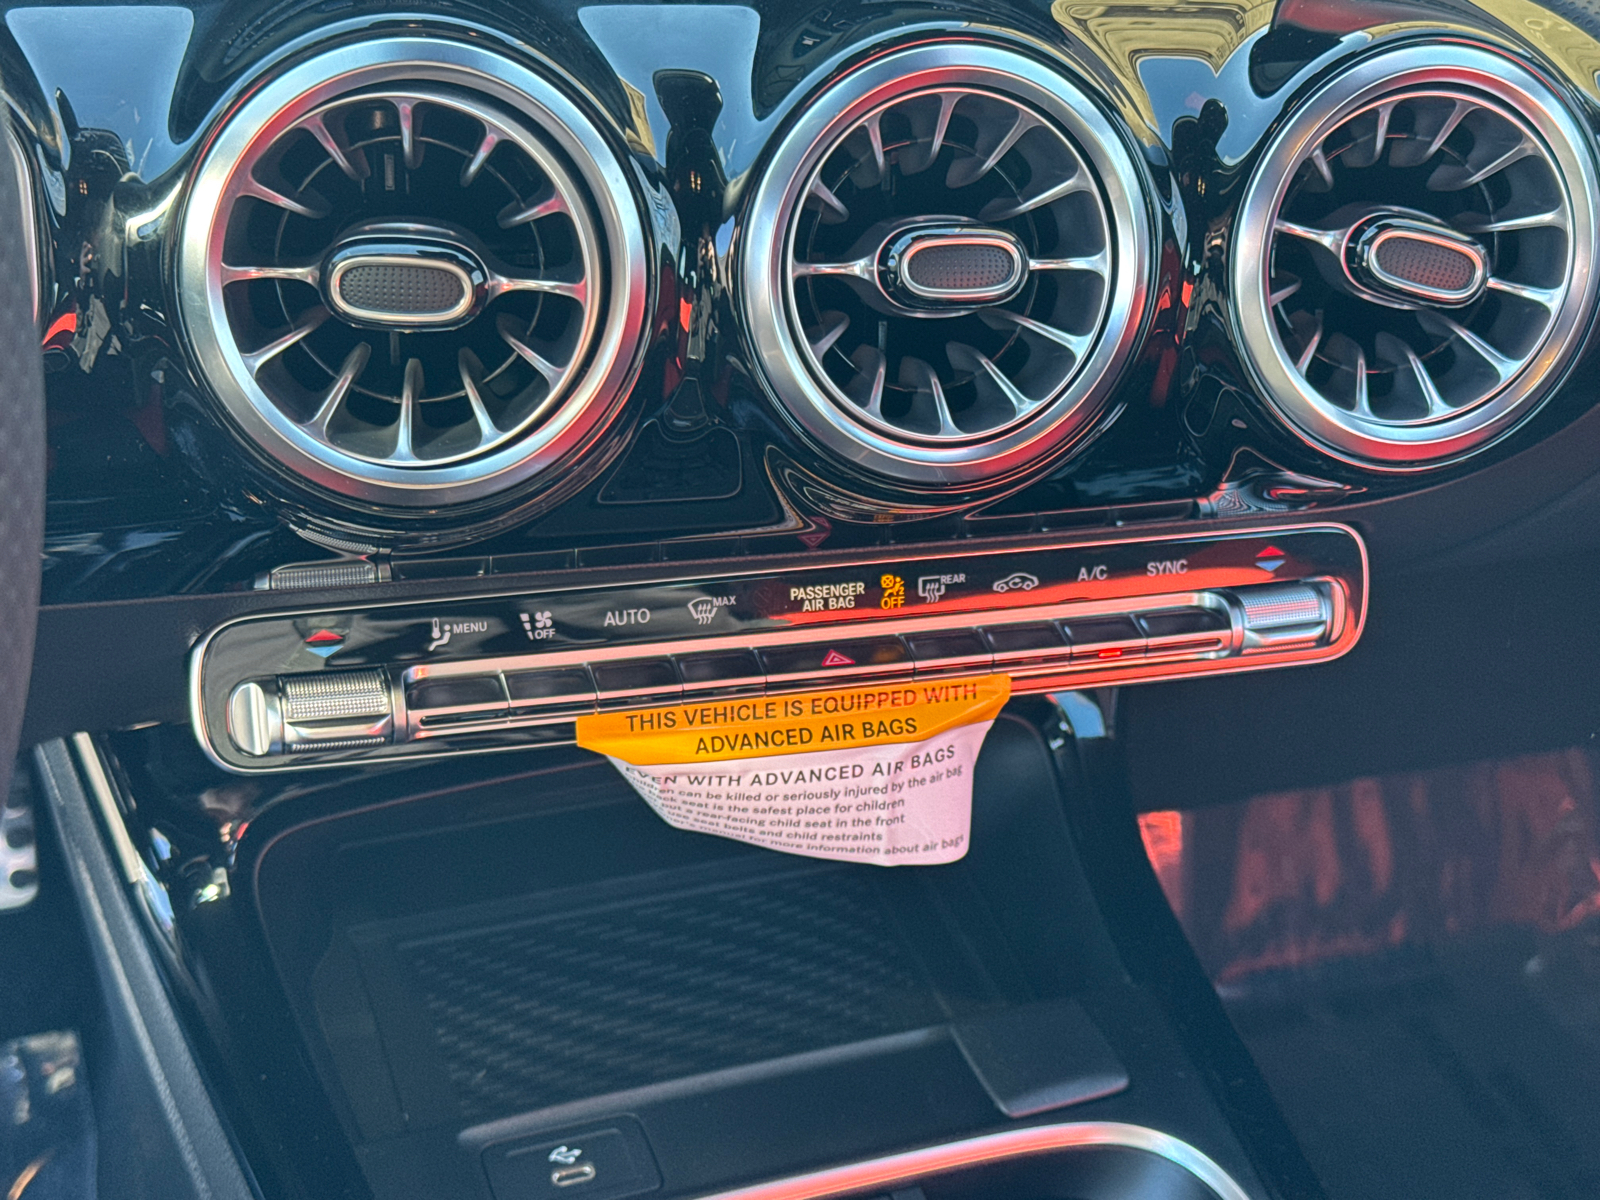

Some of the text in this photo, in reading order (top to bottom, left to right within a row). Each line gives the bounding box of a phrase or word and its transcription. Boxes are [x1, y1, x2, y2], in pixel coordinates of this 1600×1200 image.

[1077, 565, 1108, 582] A/C
[1146, 559, 1188, 577] SYNC
[940, 573, 966, 585] REAR
[790, 582, 865, 600] PASSENGER
[712, 595, 737, 607] MAX
[802, 596, 855, 612] AIR BAG
[880, 596, 905, 609] OFF
[603, 608, 651, 628] AUTO
[452, 621, 488, 635] MENU
[534, 628, 556, 640] OFF
[626, 684, 977, 732] THIS VEHICLE IS EQUIPPED WITH
[695, 717, 918, 755] ADVANCED AIR BAGS
[687, 775, 742, 787] WITH
[750, 764, 864, 786] ADVANCED
[871, 761, 905, 776] AIR
[911, 744, 955, 769] BAGS
[679, 788, 702, 798] can
[706, 791, 722, 801] be
[726, 792, 762, 801] killed
[765, 793, 780, 801] or
[783, 788, 841, 801] seriously
[844, 784, 888, 799] injured
[891, 781, 905, 793] by
[908, 777, 927, 789] the
[929, 771, 944, 784] air
[946, 765, 963, 779] bag
[681, 800, 709, 809] seat
[728, 804, 749, 813] the
[752, 805, 793, 815] safest
[796, 805, 831, 817] place
[834, 803, 852, 813] for
[856, 798, 905, 812] children
[696, 811, 766, 827] rear-facing
[769, 819, 801, 828] child
[804, 820, 833, 828] seat
[836, 818, 848, 828] in
[851, 818, 872, 828] the
[875, 814, 906, 827] front
[693, 816, 720, 827] seat
[723, 823, 756, 834] belts
[758, 830, 783, 838] and
[786, 831, 818, 841] child
[821, 832, 883, 842] restraints
[770, 840, 804, 849] more
[806, 843, 880, 855] information
[883, 844, 919, 855] about
[922, 841, 939, 852] air
[941, 834, 964, 849] bags
